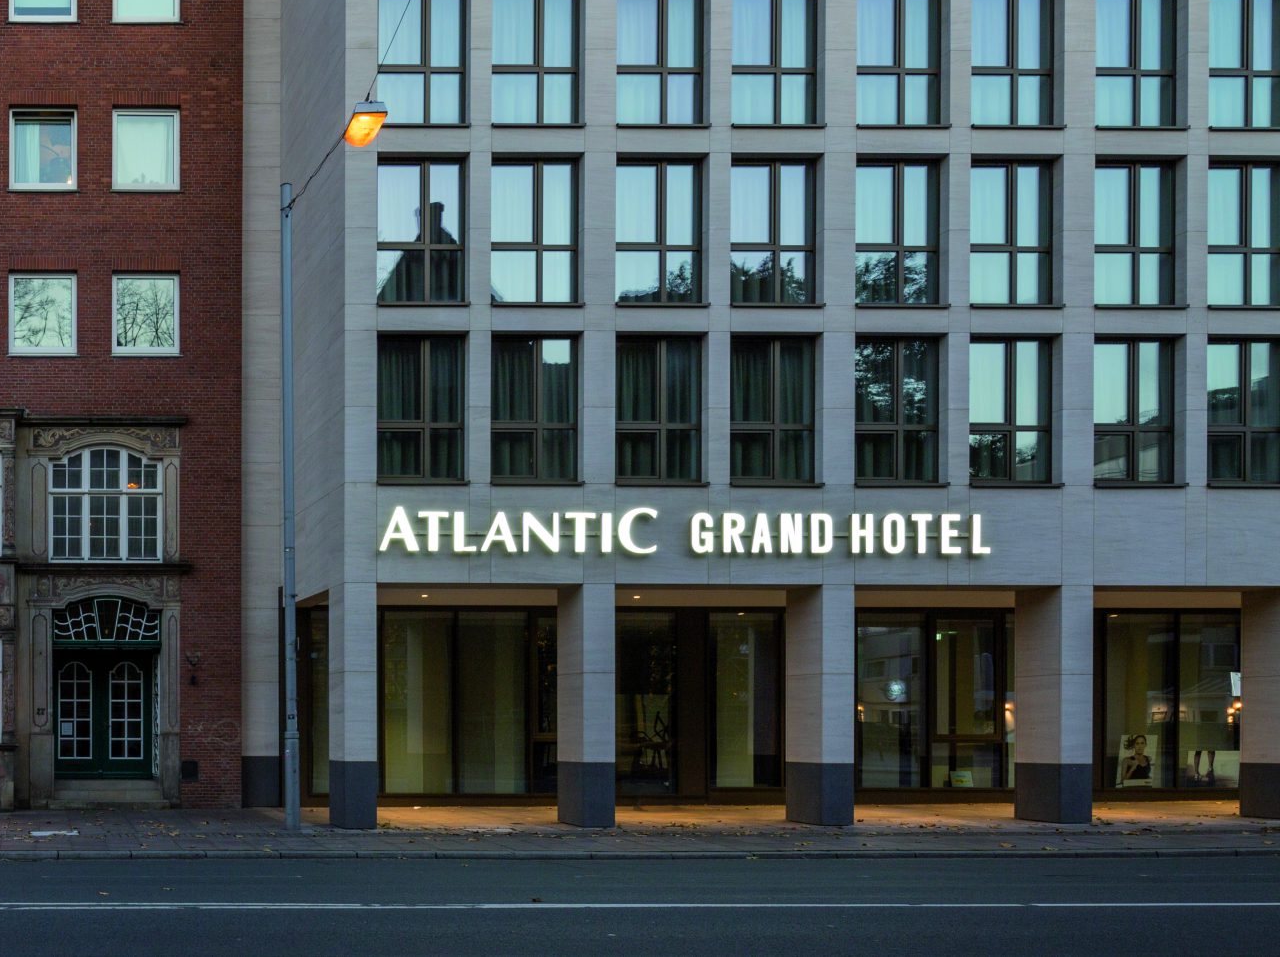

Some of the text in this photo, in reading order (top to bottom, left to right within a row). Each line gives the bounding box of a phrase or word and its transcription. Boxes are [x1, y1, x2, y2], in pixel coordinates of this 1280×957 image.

[379, 505, 992, 555] ATLANTIC GRAND HOTEL
